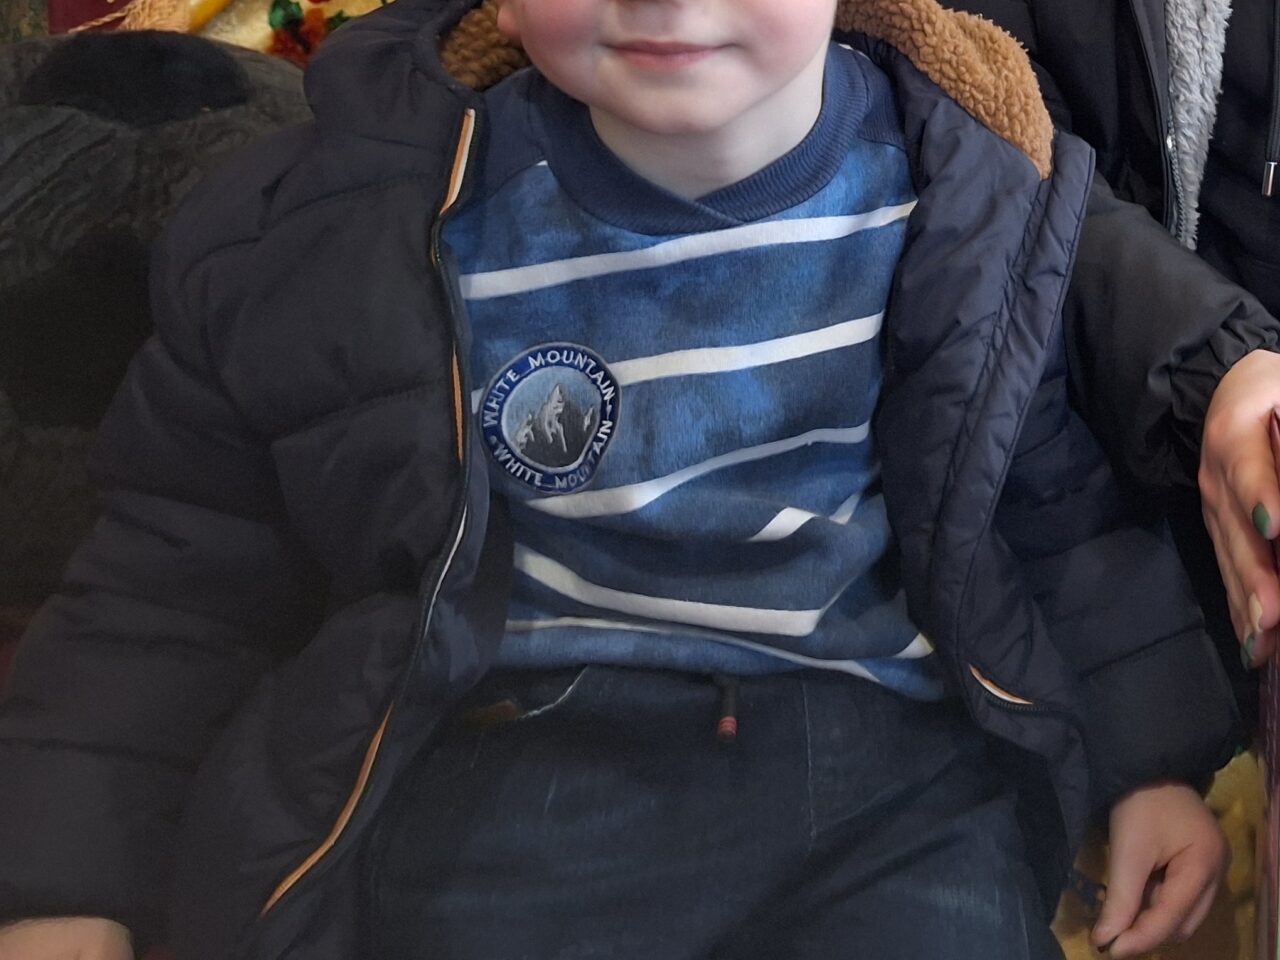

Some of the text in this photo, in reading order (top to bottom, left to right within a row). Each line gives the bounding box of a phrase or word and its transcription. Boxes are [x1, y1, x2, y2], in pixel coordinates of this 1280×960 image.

[482, 349, 616, 428] WHITE MOUNTAIN
[493, 443, 543, 487] WHITE
